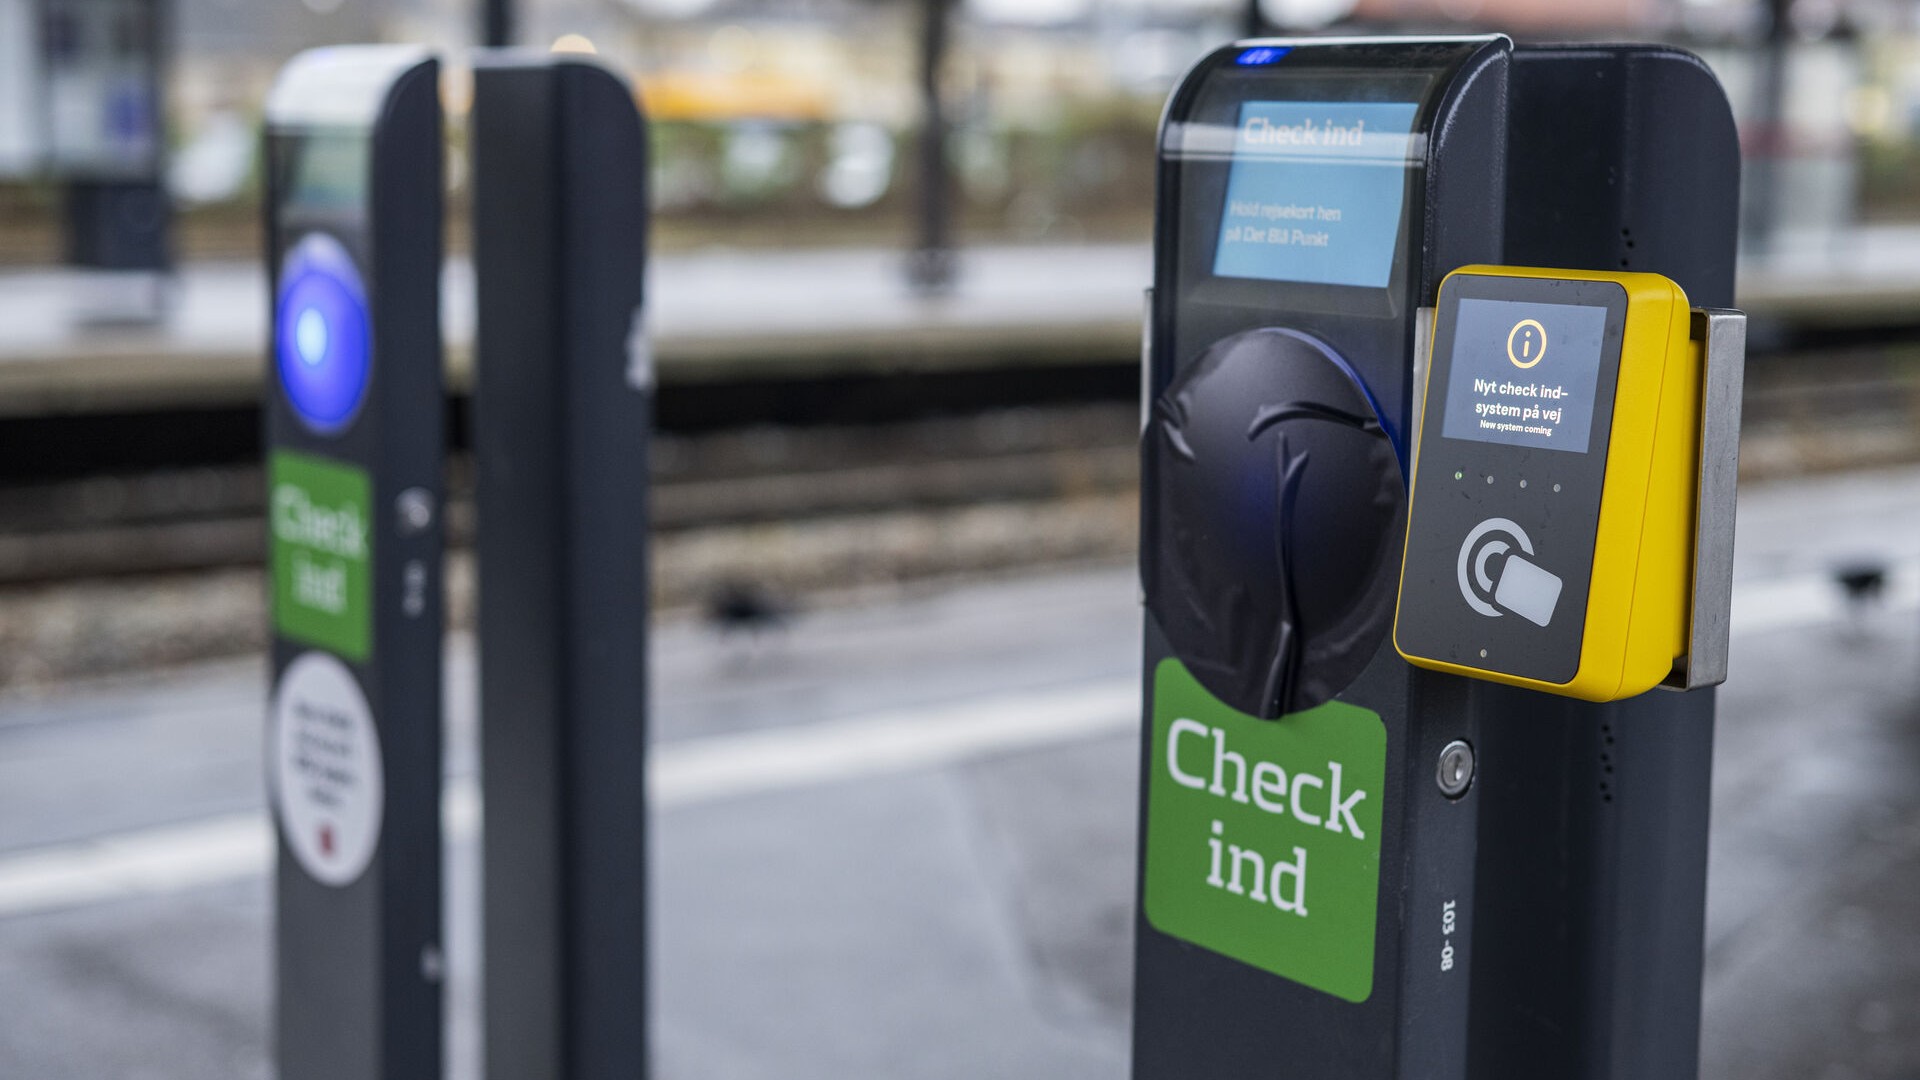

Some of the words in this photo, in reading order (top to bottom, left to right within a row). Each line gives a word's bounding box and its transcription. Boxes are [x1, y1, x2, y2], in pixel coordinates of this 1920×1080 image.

[1243, 117, 1319, 145] Check
[1322, 118, 1365, 146] ind
[1230, 201, 1259, 218] Hold
[1317, 206, 1342, 222] hen
[1291, 229, 1329, 247] Punkt
[1474, 378, 1497, 397] Nyt
[1499, 381, 1538, 398] check
[1475, 402, 1521, 417] system
[1522, 404, 1540, 421] på
[1542, 407, 1562, 424] vej
[1480, 419, 1497, 430] New
[1497, 421, 1524, 432] system
[1524, 425, 1553, 436] coming
[1167, 717, 1367, 840] Check
[1206, 819, 1308, 917] ind
